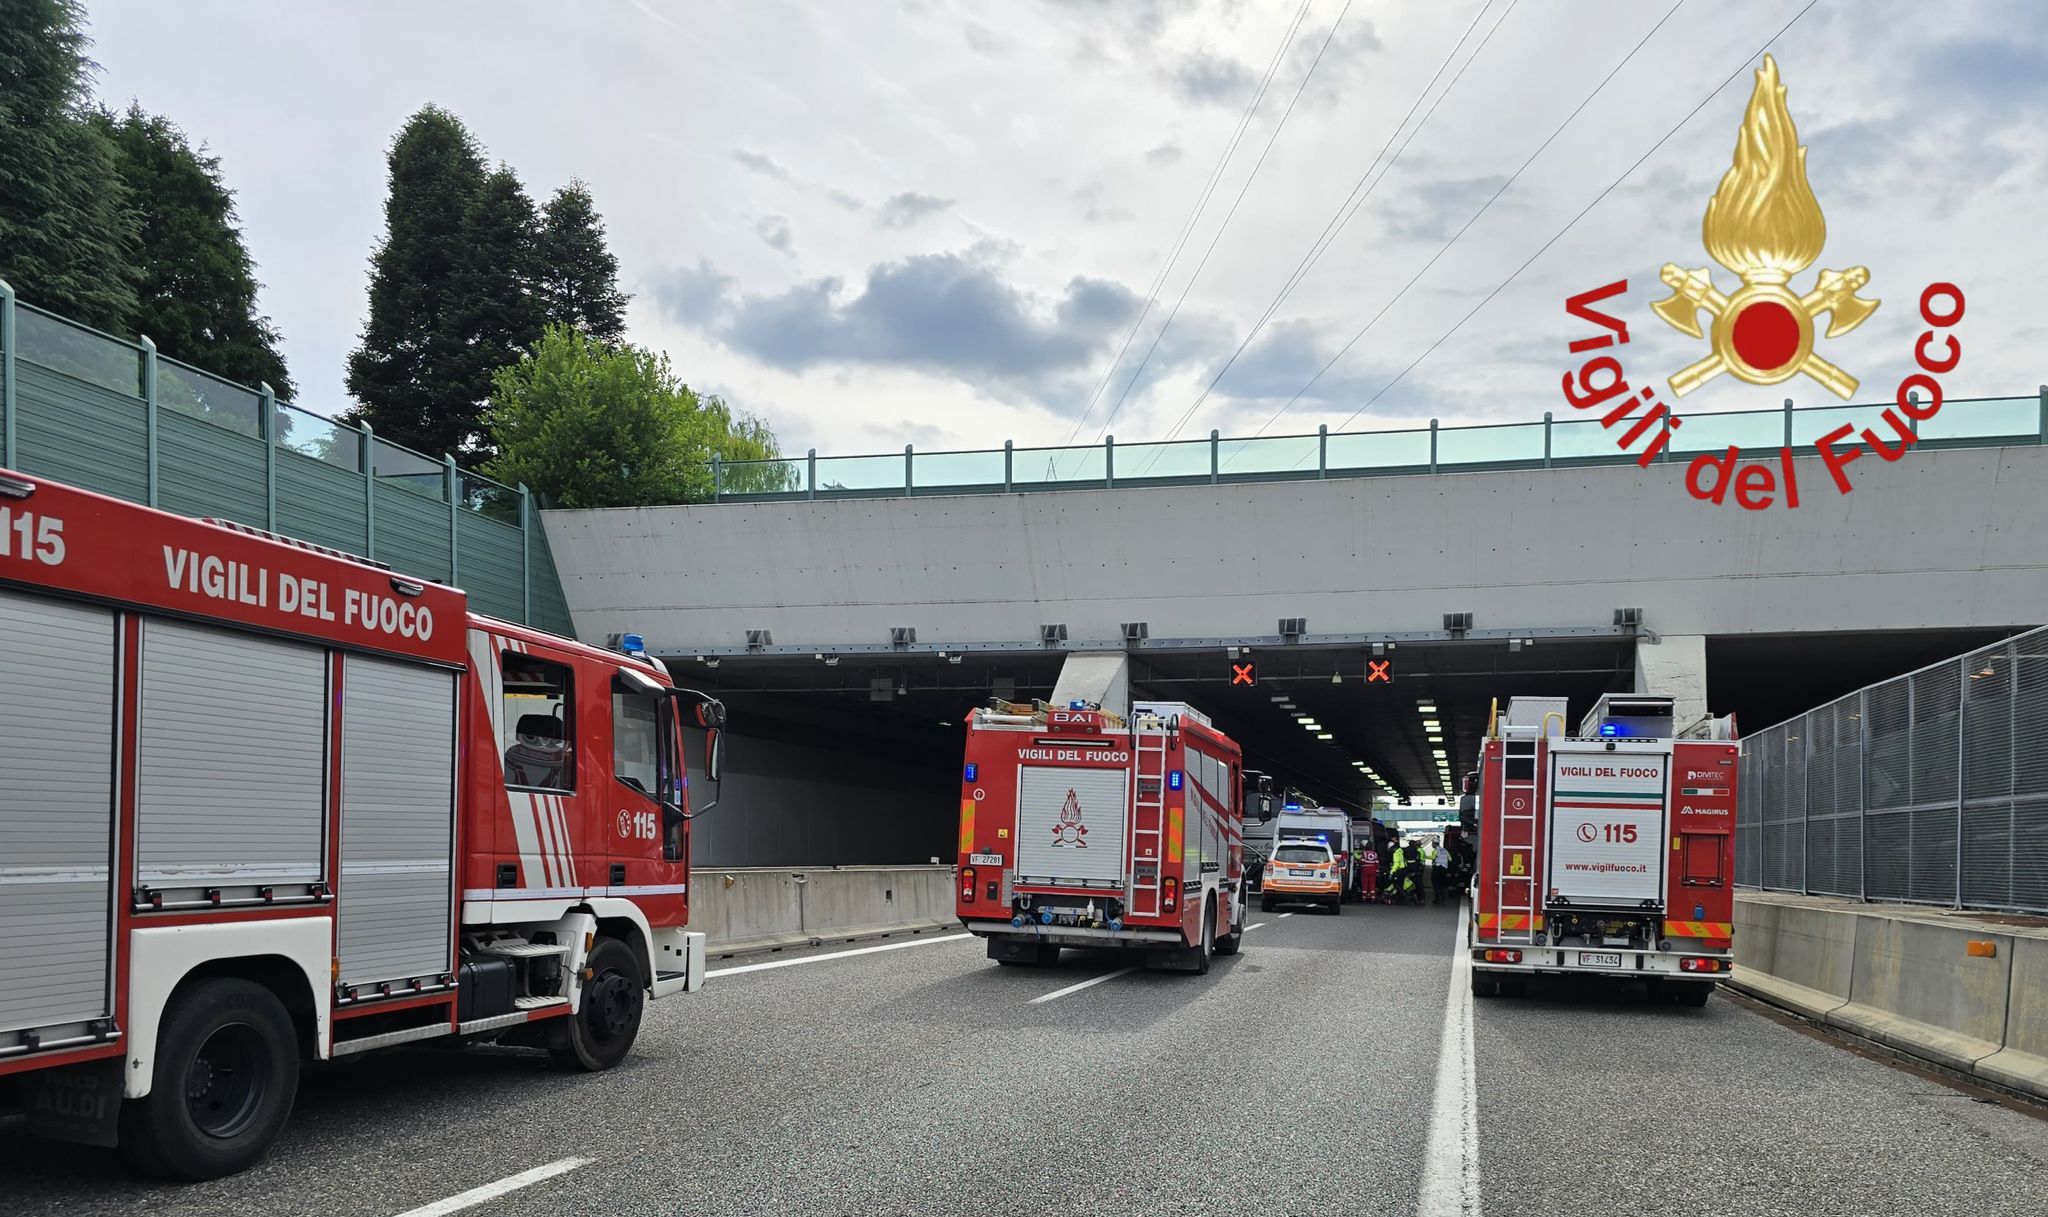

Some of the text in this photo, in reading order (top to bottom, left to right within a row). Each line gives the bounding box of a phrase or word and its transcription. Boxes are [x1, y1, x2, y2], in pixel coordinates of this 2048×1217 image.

[0, 506, 66, 566] 115
[163, 544, 434, 642] VIGILI DEL FUOCO
[1054, 712, 1093, 723] BAI
[1018, 748, 1129, 762] VIGILI DEL FUOCO
[1560, 766, 1659, 778] VIGILI DEL FUOCO
[1695, 808, 1729, 816] MAGIRUS
[633, 811, 657, 840] 115
[1603, 824, 1638, 844] 115
[971, 855, 979, 864] VF
[1565, 862, 1647, 874] www.vigilfuoco.it
[1582, 954, 1591, 963] VF
